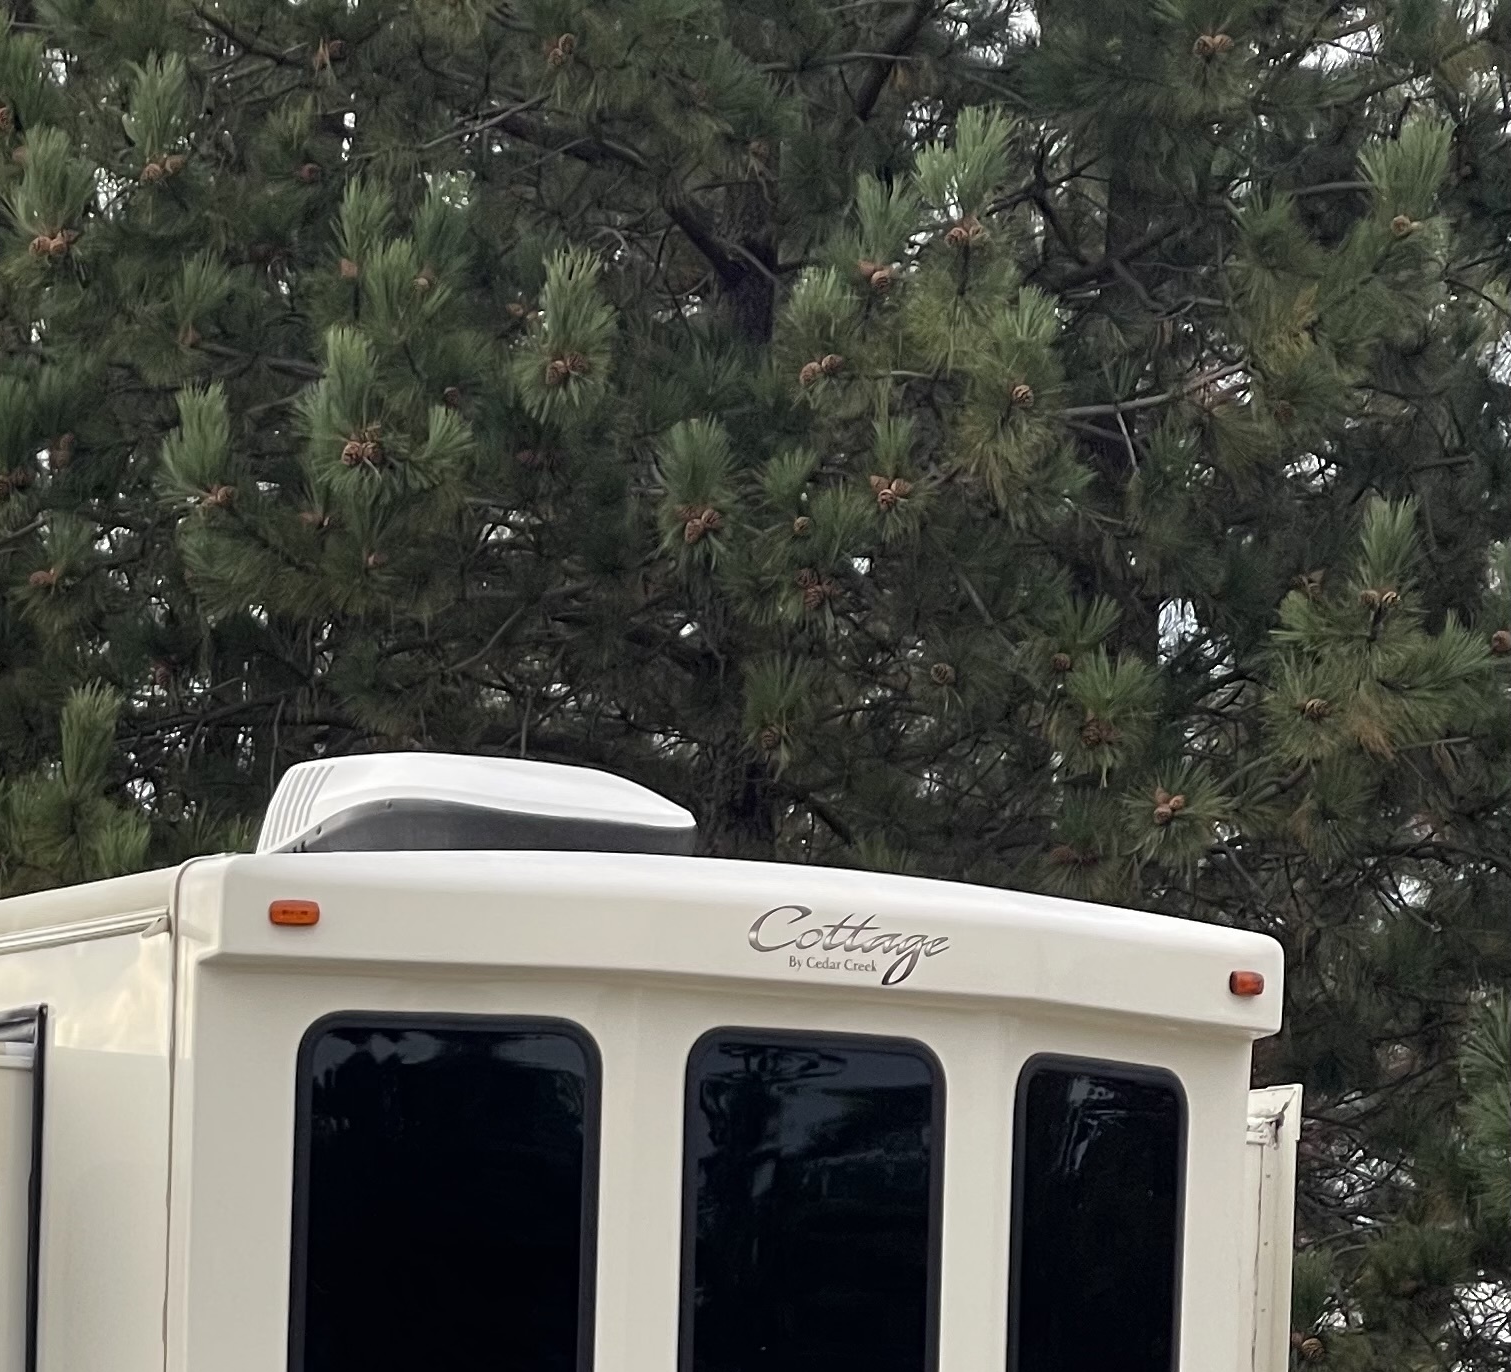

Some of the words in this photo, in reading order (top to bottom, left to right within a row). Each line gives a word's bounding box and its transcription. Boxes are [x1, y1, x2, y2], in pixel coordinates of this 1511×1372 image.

[748, 905, 951, 985] Cottage
[789, 955, 803, 972] By
[806, 956, 841, 970] Cedar
[844, 958, 877, 972] Creek
